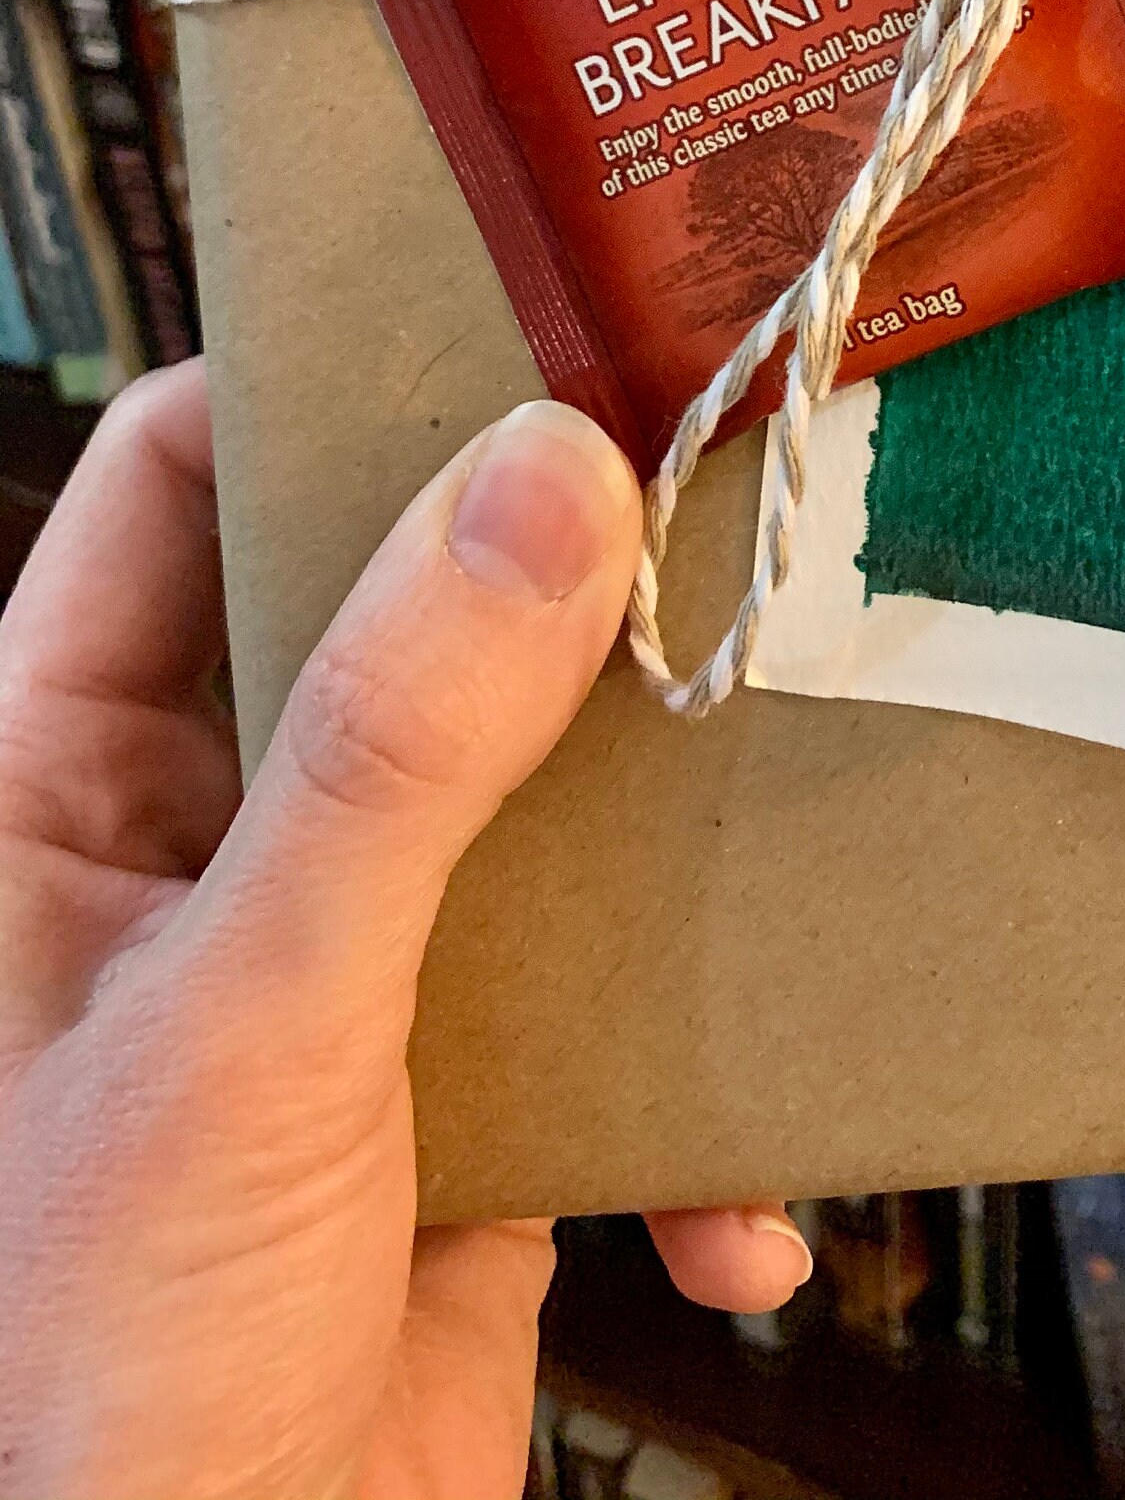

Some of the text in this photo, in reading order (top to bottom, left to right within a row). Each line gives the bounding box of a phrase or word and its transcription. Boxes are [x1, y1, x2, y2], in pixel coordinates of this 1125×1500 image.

[600, 122, 658, 163] Enjoy
[664, 104, 703, 134] the
[707, 62, 803, 115] smooth,
[602, 55, 898, 197] of this classic tea any time
[857, 310, 905, 341] tea
[903, 286, 963, 321] bag
